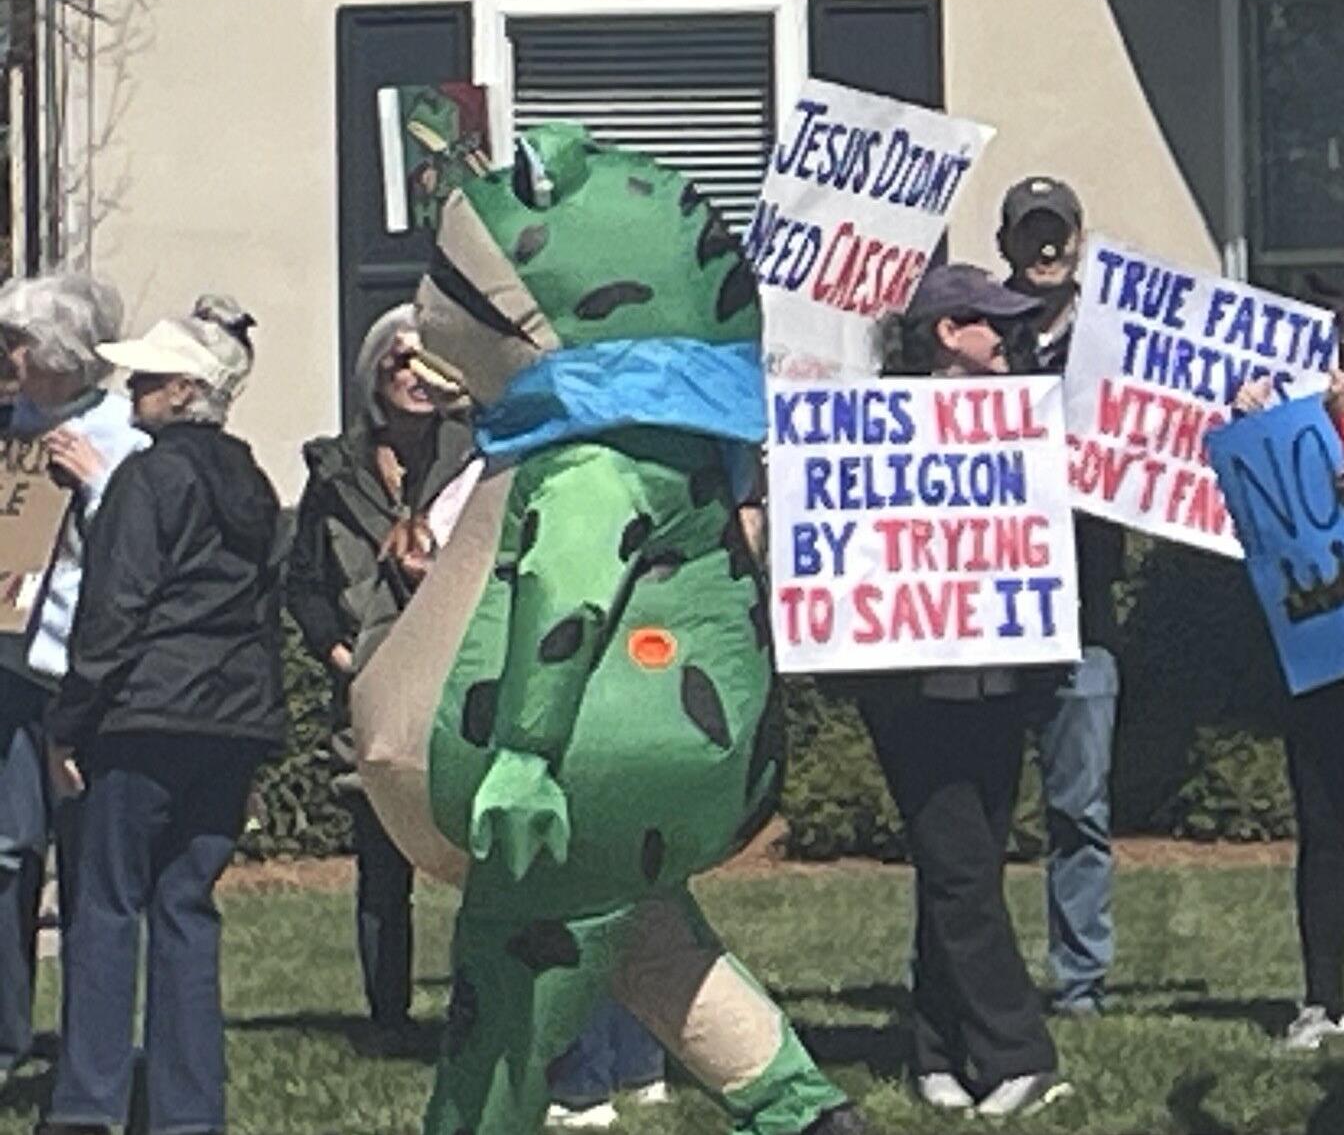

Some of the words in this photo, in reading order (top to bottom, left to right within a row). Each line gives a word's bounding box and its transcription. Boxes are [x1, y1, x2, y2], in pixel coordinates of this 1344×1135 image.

[776, 98, 882, 194] JESUS
[742, 199, 822, 291] NEED
[1097, 248, 1195, 329] TRUE
[1203, 287, 1338, 373] FAITH
[774, 388, 915, 445] KINGS
[934, 388, 1048, 444] KILL
[803, 450, 1027, 510] RELIGION
[1230, 423, 1340, 550] NO
[792, 521, 857, 577] BY
[873, 516, 1050, 572] TRYING
[779, 586, 834, 646] TO
[852, 580, 984, 644] SAVE
[994, 577, 1062, 638] IT
